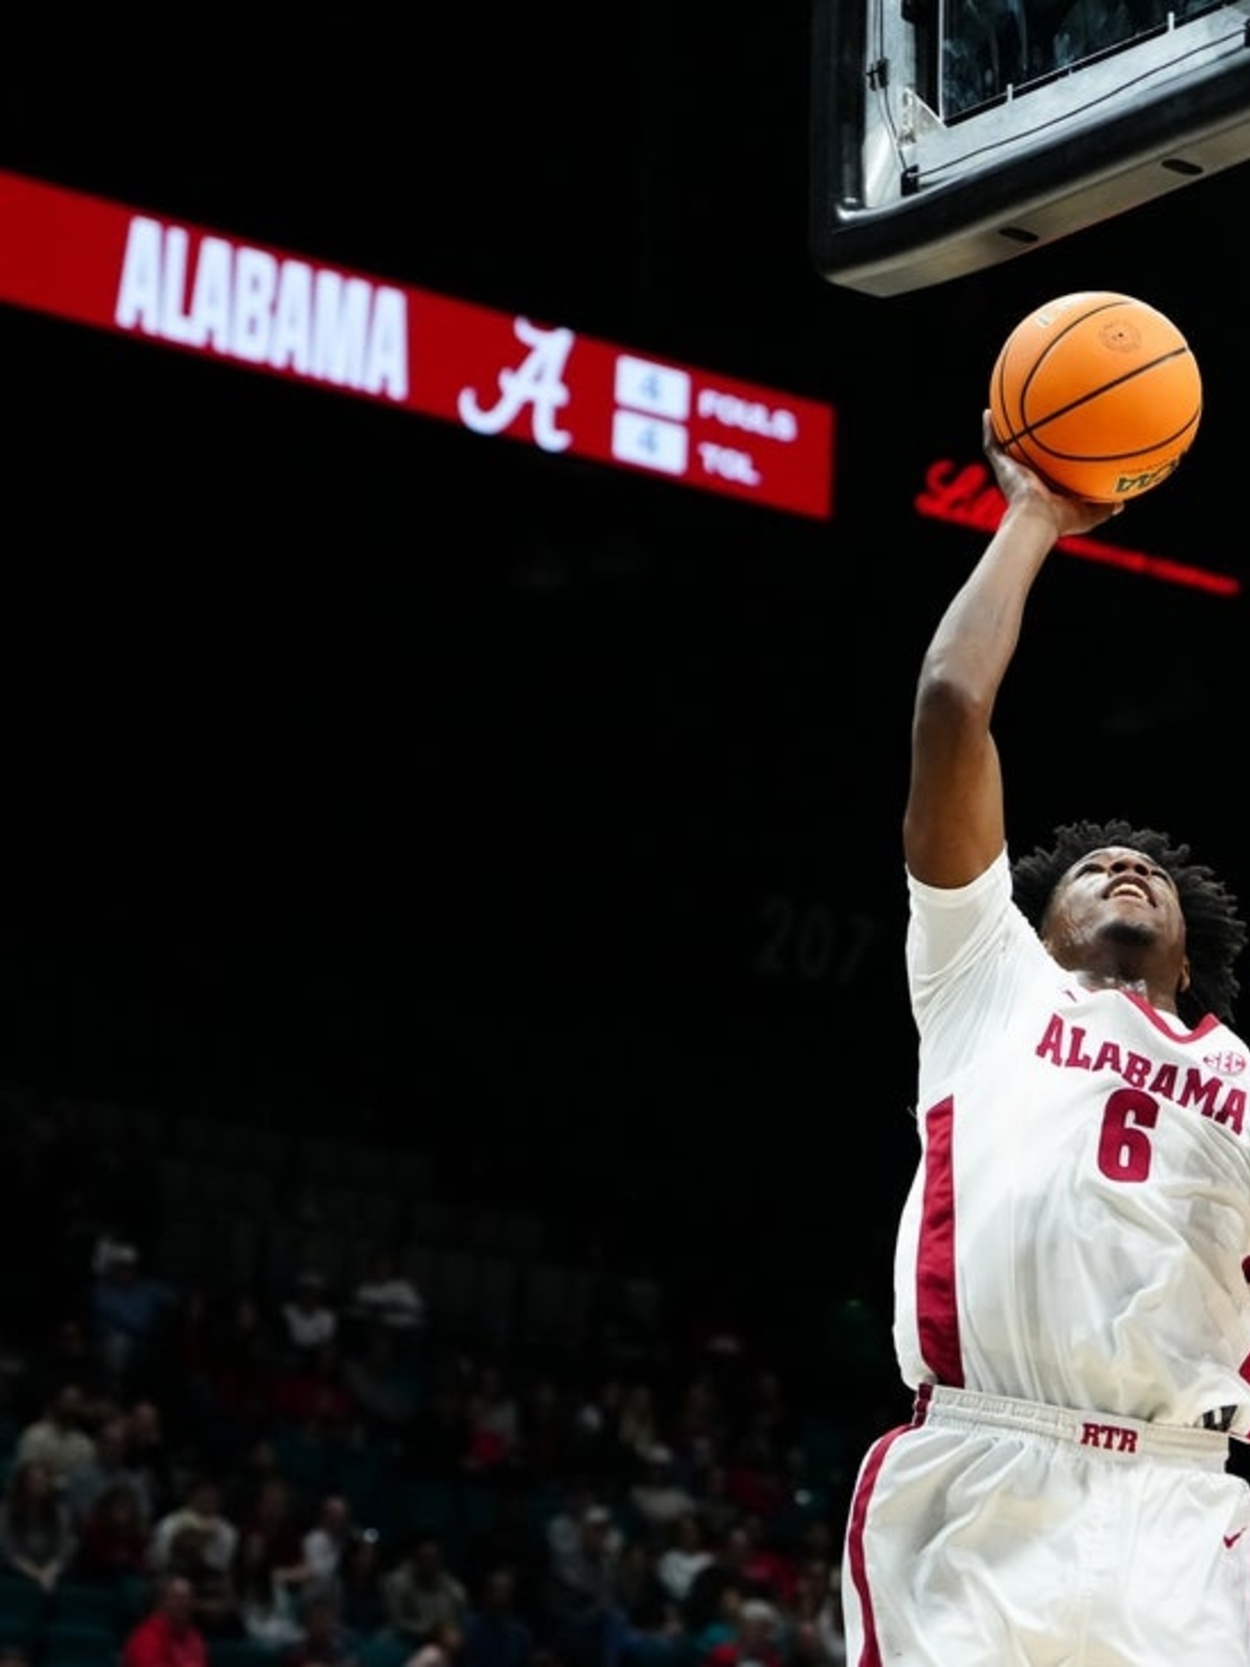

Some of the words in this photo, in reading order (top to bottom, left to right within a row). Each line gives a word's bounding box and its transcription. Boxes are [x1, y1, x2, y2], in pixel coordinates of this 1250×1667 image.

[116, 215, 409, 402] ALABAMA
[698, 388, 798, 443] FOULS
[752, 893, 876, 989] 207
[1035, 1013, 1248, 1137] ALABAMA
[1203, 1051, 1247, 1075] SEC
[1097, 1088, 1161, 1184] 6
[1080, 1422, 1139, 1454] RTR
